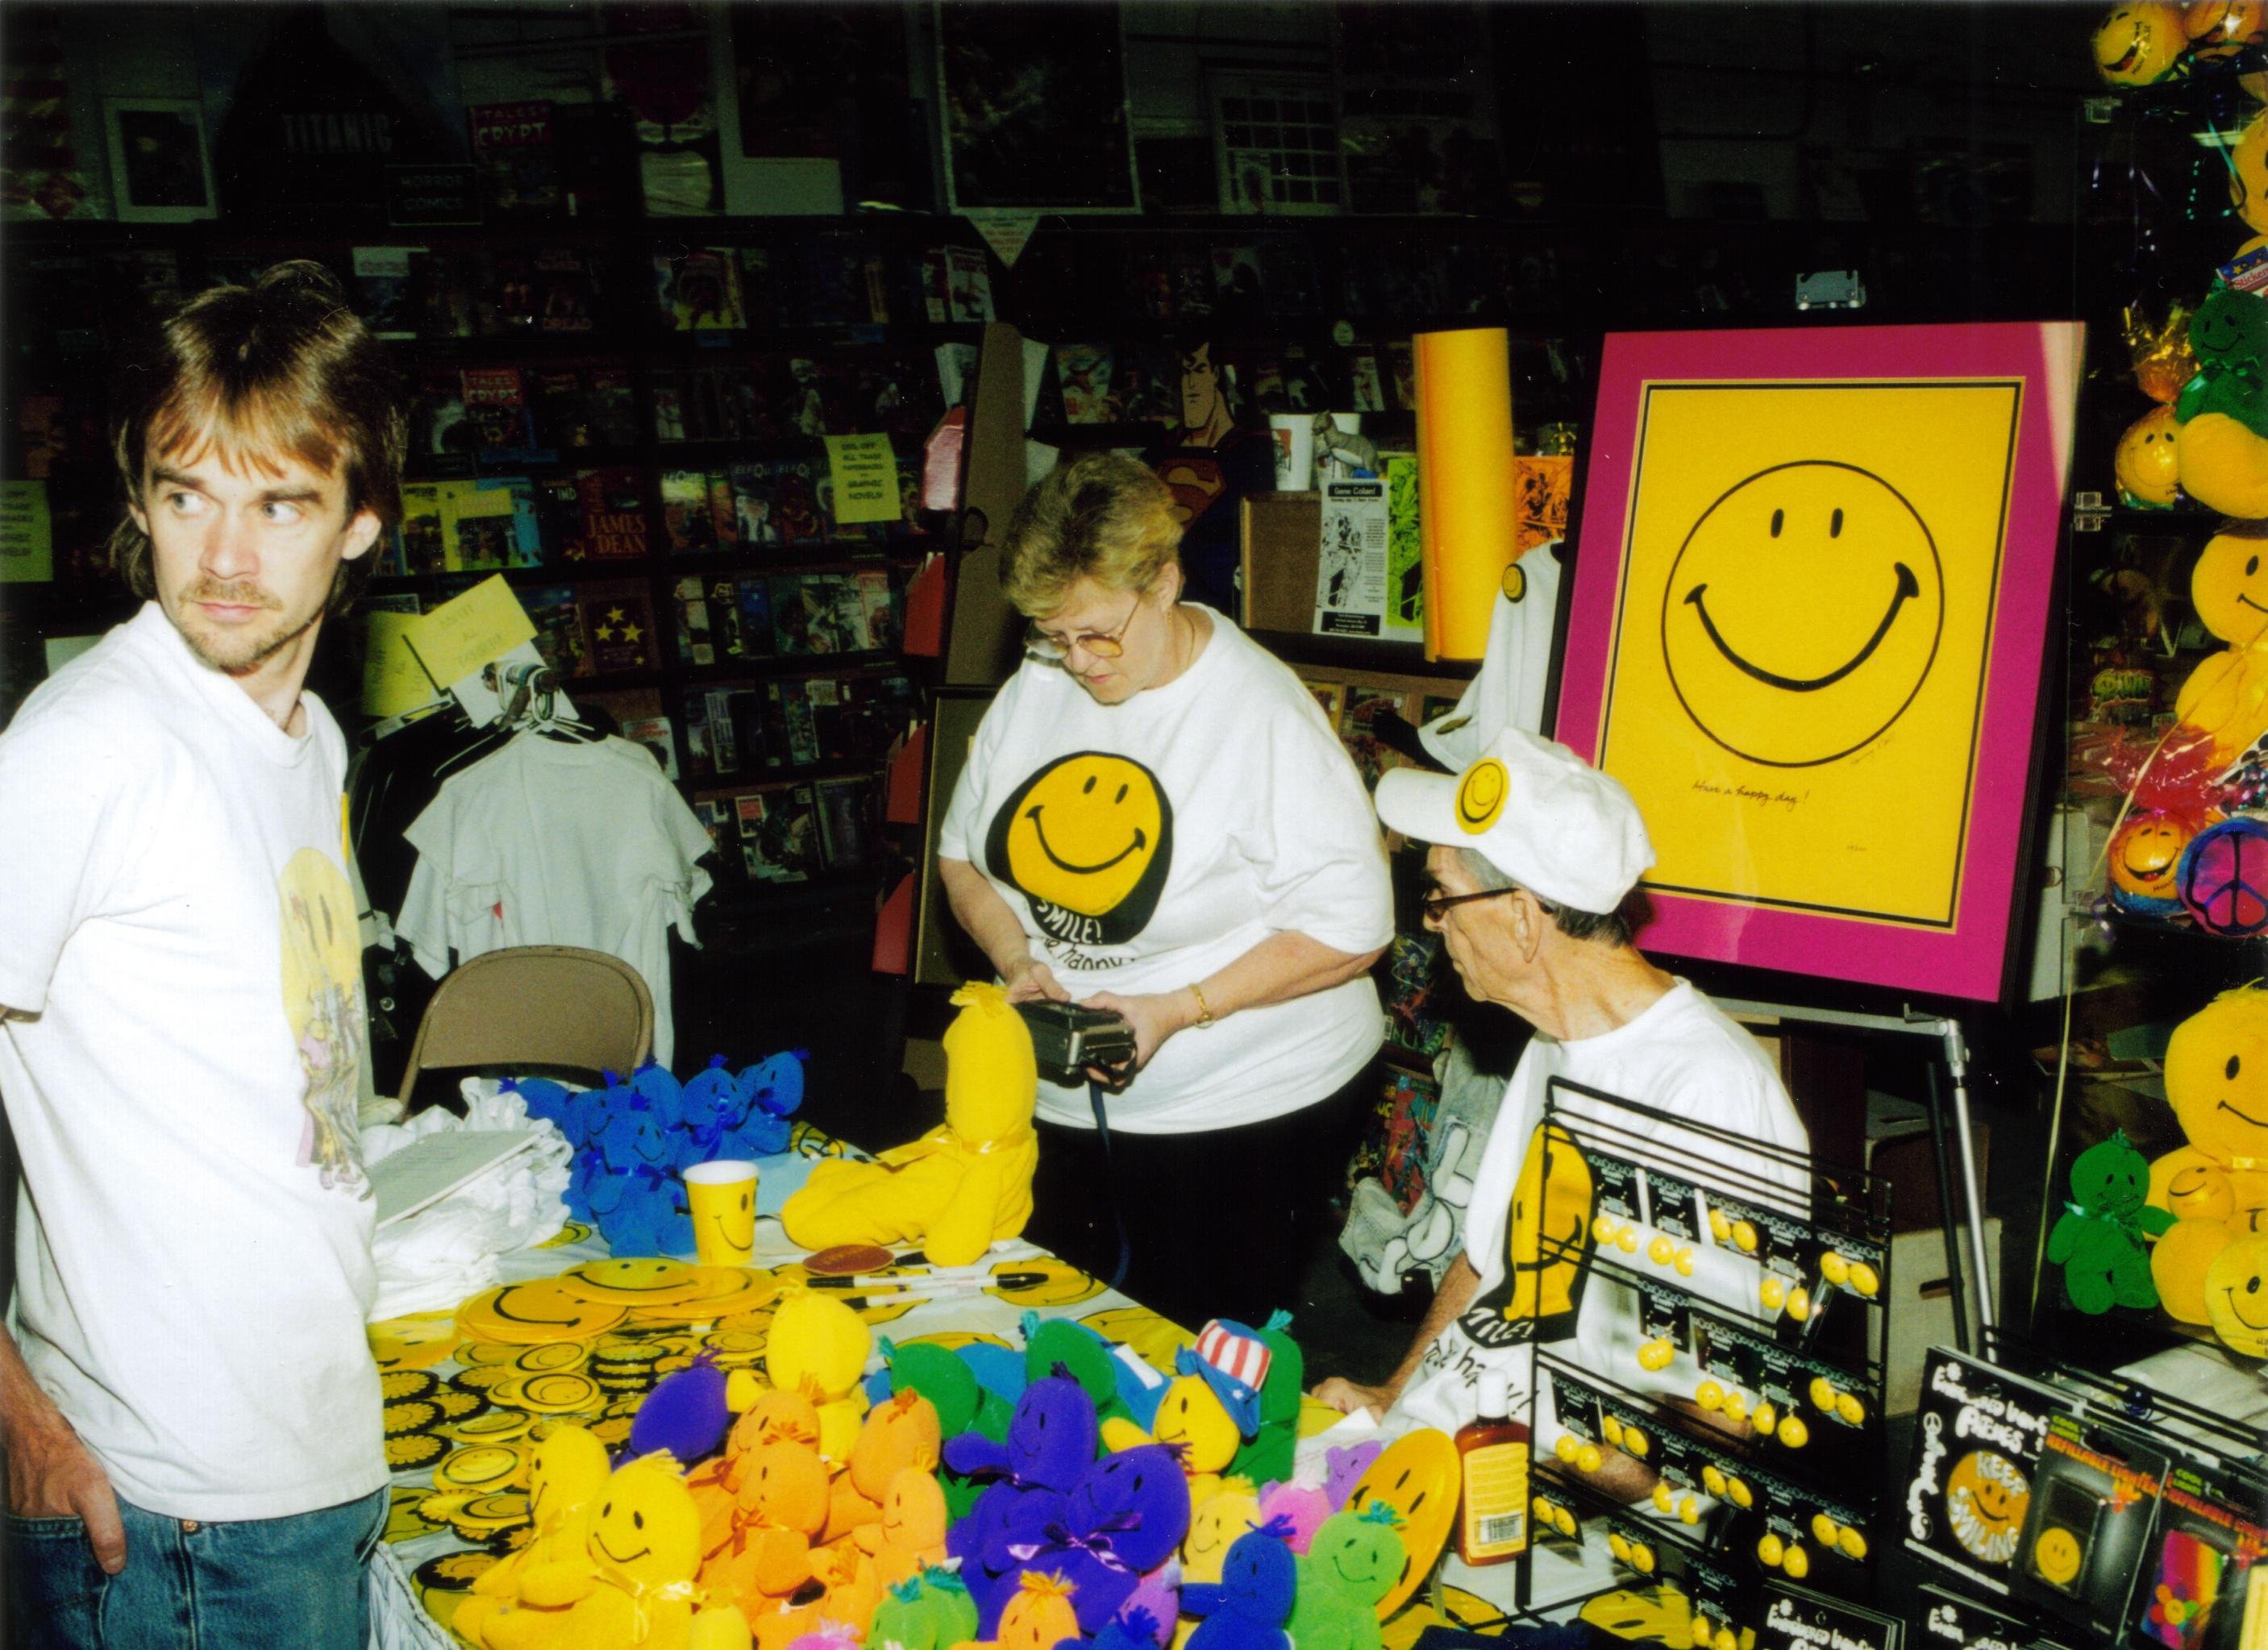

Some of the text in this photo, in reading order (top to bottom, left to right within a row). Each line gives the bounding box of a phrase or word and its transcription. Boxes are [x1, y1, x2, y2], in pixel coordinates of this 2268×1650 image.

[281, 113, 393, 155] TITANIC
[477, 122, 547, 148] CRYPT
[587, 513, 647, 538] JAMES
[595, 534, 646, 555] DEAN
[1692, 779, 1721, 793] Have
[1735, 785, 1772, 807] happy
[1774, 791, 1799, 812] day
[1037, 899, 1103, 944] SMILE!
[1976, 1451, 2026, 1497] KEEP
